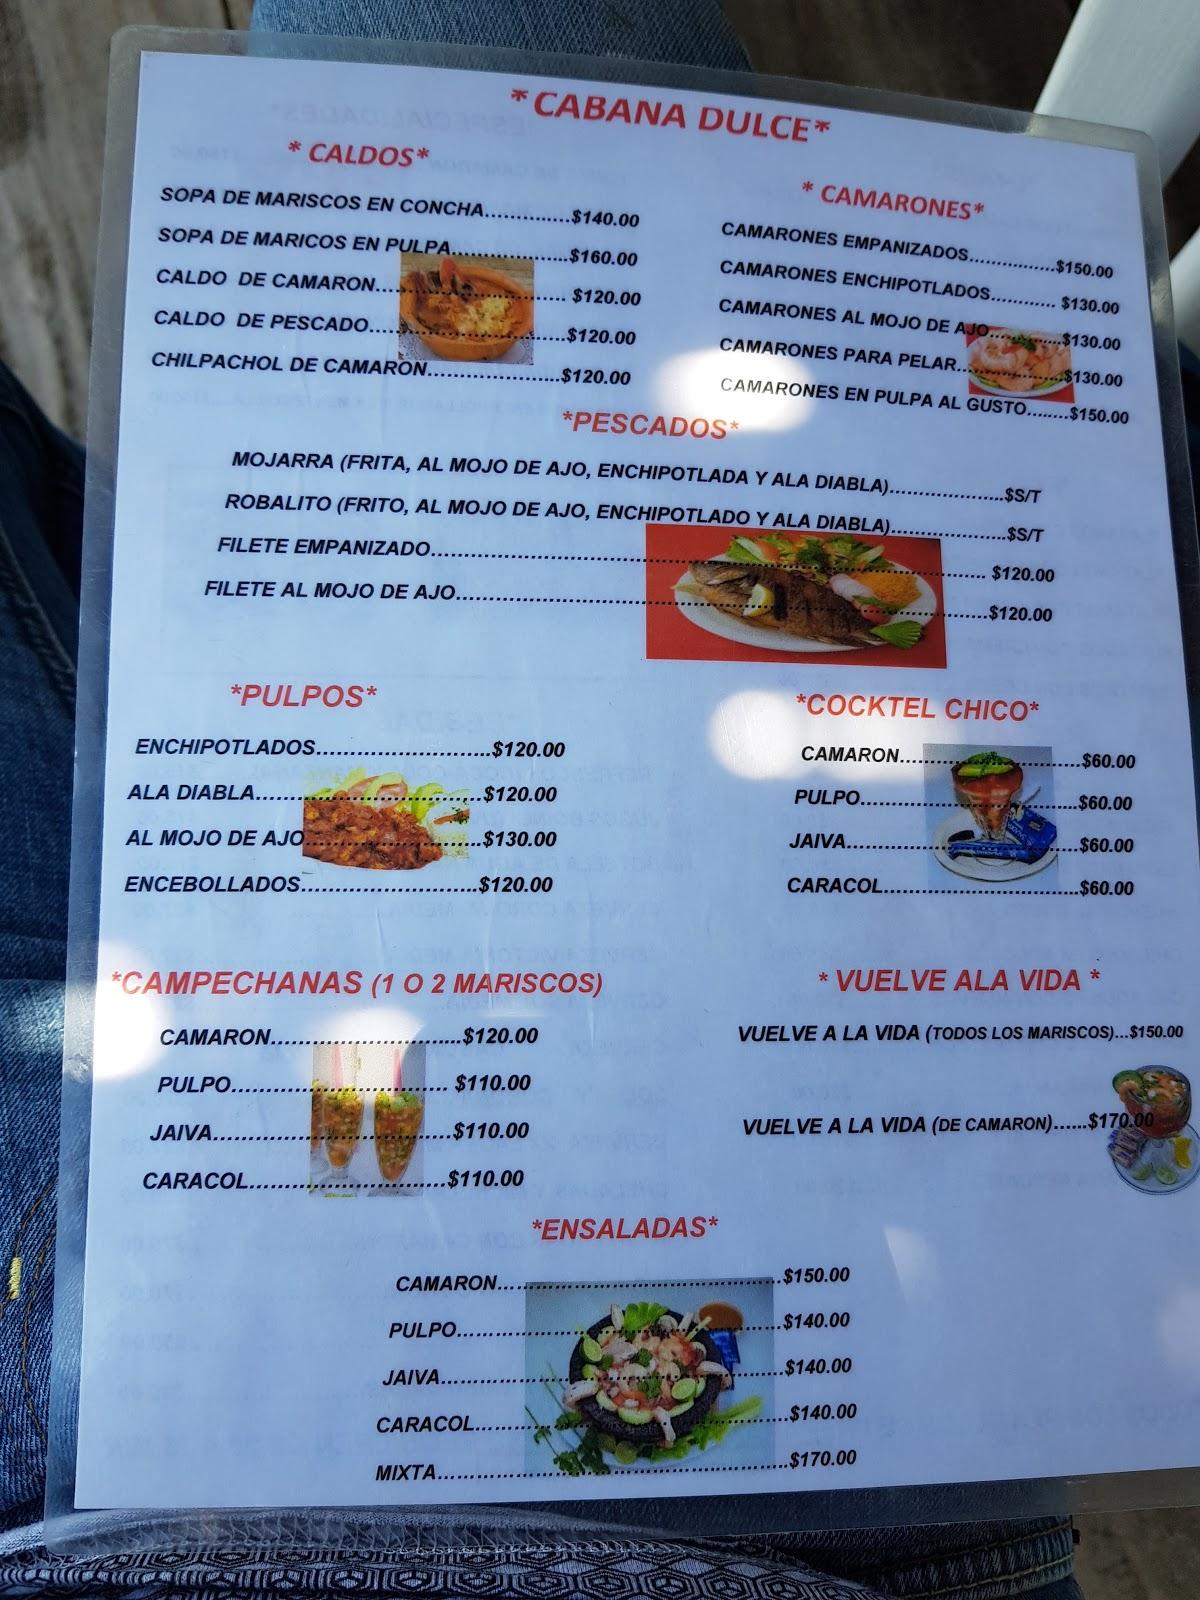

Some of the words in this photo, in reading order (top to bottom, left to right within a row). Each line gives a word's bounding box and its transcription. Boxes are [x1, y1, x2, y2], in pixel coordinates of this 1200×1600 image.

[160, 187, 216, 204] SOPA
[222, 190, 251, 205] DE
[254, 191, 362, 210] MARISCOS
[366, 196, 395, 212] EN
[399, 198, 484, 218] CONCHA
[571, 208, 640, 228] $140.00
[157, 227, 214, 244] SOPA
[220, 230, 250, 246] DE
[252, 231, 348, 250] MARICOS
[352, 236, 381, 252] EN
[386, 237, 451, 255] PULPA
[569, 247, 638, 267] $160.00
[721, 222, 838, 246] CAMARONES
[842, 234, 969, 262] EMPANIZADOS
[1055, 259, 1114, 279] $150.00
[156, 268, 228, 286] CALDO
[238, 271, 267, 287] DE
[272, 273, 376, 292] CAMARON
[572, 287, 642, 306] $120.00
[720, 260, 837, 284] CAMARONES
[842, 271, 990, 301] ENCHIPOTLADOS
[1061, 295, 1120, 315] $130.00
[154, 310, 226, 327] CALDO
[236, 312, 266, 329] DE
[269, 314, 369, 333] PESCADO
[566, 327, 637, 346] $120.00
[718, 298, 837, 322] CAMARONES
[840, 309, 865, 325] AL
[869, 312, 922, 330] MOJO
[926, 318, 951, 334] DE
[954, 321, 990, 337] AJO
[1062, 332, 1121, 351] $130.00
[151, 351, 284, 372] CHILPACHOL
[289, 356, 319, 373] DE
[323, 358, 427, 377] CAMARON
[560, 367, 632, 386] $120.00
[720, 337, 838, 361] CAMARONES
[843, 347, 893, 366] PARA
[897, 352, 957, 372] PELAR
[1064, 368, 1123, 388] $130.00
[720, 377, 839, 401] CAMARONES
[844, 386, 870, 402] EN
[874, 389, 933, 408] PULPA
[937, 395, 961, 410] AL
[966, 396, 1030, 416] GUSTO
[1069, 406, 1130, 425] $150.00
[231, 451, 334, 469] MOJARRA
[340, 454, 411, 474] (FRITA,
[416, 456, 444, 472] AL
[449, 457, 509, 474] MOJO
[513, 459, 542, 475] DE
[545, 460, 591, 480] AJO,
[597, 462, 749, 485] ENCHIPOTLADA
[755, 470, 769, 486] Y
[771, 472, 809, 489] ALA
[814, 474, 889, 497] DIABLA)
[1004, 487, 1042, 504] $S/T
[224, 493, 332, 512] ROBALITO
[337, 496, 409, 516] (FRITO,
[414, 498, 442, 514] AL
[447, 499, 507, 516] MOJO
[512, 501, 541, 517] DE
[544, 502, 590, 521] AJO,
[598, 504, 751, 526] ENCHIPOTLADO
[756, 511, 770, 526] Y
[772, 512, 811, 529] ALA
[815, 515, 891, 536] DIABLA)
[1006, 526, 1045, 543] $S/T
[217, 536, 290, 554] FILETE
[293, 538, 431, 557] EMPANIZADO
[991, 564, 1055, 583] $120.00
[204, 580, 277, 597] FILETE
[280, 582, 308, 598] AL
[313, 582, 375, 599] MOJO
[379, 583, 410, 600] DE
[413, 584, 456, 601] AJO
[988, 604, 1053, 623] $120.00
[135, 738, 316, 756] ENCHIPOTLADOS
[491, 740, 566, 759] $120.00
[801, 745, 900, 763] CAMARON
[1081, 752, 1136, 770] $60.00
[126, 784, 170, 801] ALA
[176, 784, 255, 801] DIABLA
[482, 785, 558, 804] $120.00
[794, 789, 861, 806] PULPO
[1078, 794, 1133, 812] $60.00
[125, 829, 154, 846] AL
[159, 829, 222, 847] MOJO
[227, 829, 258, 846] DE
[261, 830, 305, 848] AJO
[482, 829, 558, 849] $130.00
[788, 832, 846, 849] JAIVA
[1079, 836, 1134, 855] $60.00
[124, 875, 301, 893] ENCEBOLLADOS
[478, 875, 554, 895] $120.00
[787, 877, 883, 894] CARACOL
[1079, 879, 1135, 897] $60.00
[371, 973, 394, 999] (1
[403, 973, 424, 994] O
[431, 973, 446, 994] 2
[453, 972, 603, 999] MARISCOS)
[836, 969, 947, 992] VUELVE
[953, 969, 1009, 991] ALA
[1019, 969, 1081, 991] VIDA
[160, 1028, 272, 1046] CAMARON
[462, 1026, 539, 1047] $120.00
[738, 1025, 818, 1042] VUELVE
[822, 1025, 837, 1042] A
[842, 1024, 869, 1041] LA
[875, 1024, 920, 1041] VIDA
[925, 1024, 988, 1045] (TODOS
[991, 1026, 1024, 1040] LOS
[1027, 1025, 1115, 1042] MARISCOS)
[1129, 1024, 1184, 1040] $150.00
[157, 1076, 232, 1094] PULPO
[454, 1073, 532, 1094] $110.00
[149, 1124, 212, 1142] JAIVA
[452, 1121, 530, 1141] $110.00
[743, 1117, 824, 1136] VUELVE
[827, 1117, 842, 1134] A
[847, 1117, 874, 1134] LA
[881, 1116, 926, 1133] VIDA
[931, 1115, 962, 1136] (DE
[965, 1113, 1053, 1134] CAMARON)
[1088, 1112, 1155, 1130] $170.00
[142, 1171, 249, 1190] CARACOL
[447, 1169, 525, 1190] $110.00
[396, 1274, 498, 1292] CAMARON
[782, 1266, 851, 1286] $150.00
[388, 1321, 457, 1339] PULPO
[782, 1311, 851, 1331] $140.00
[382, 1368, 440, 1386] JAIVA
[784, 1357, 852, 1377] $140.00
[376, 1415, 475, 1434] CARACOL
[789, 1403, 858, 1423] $140.00
[375, 1463, 436, 1481] MIXTA
[789, 1449, 857, 1470] $170.00
